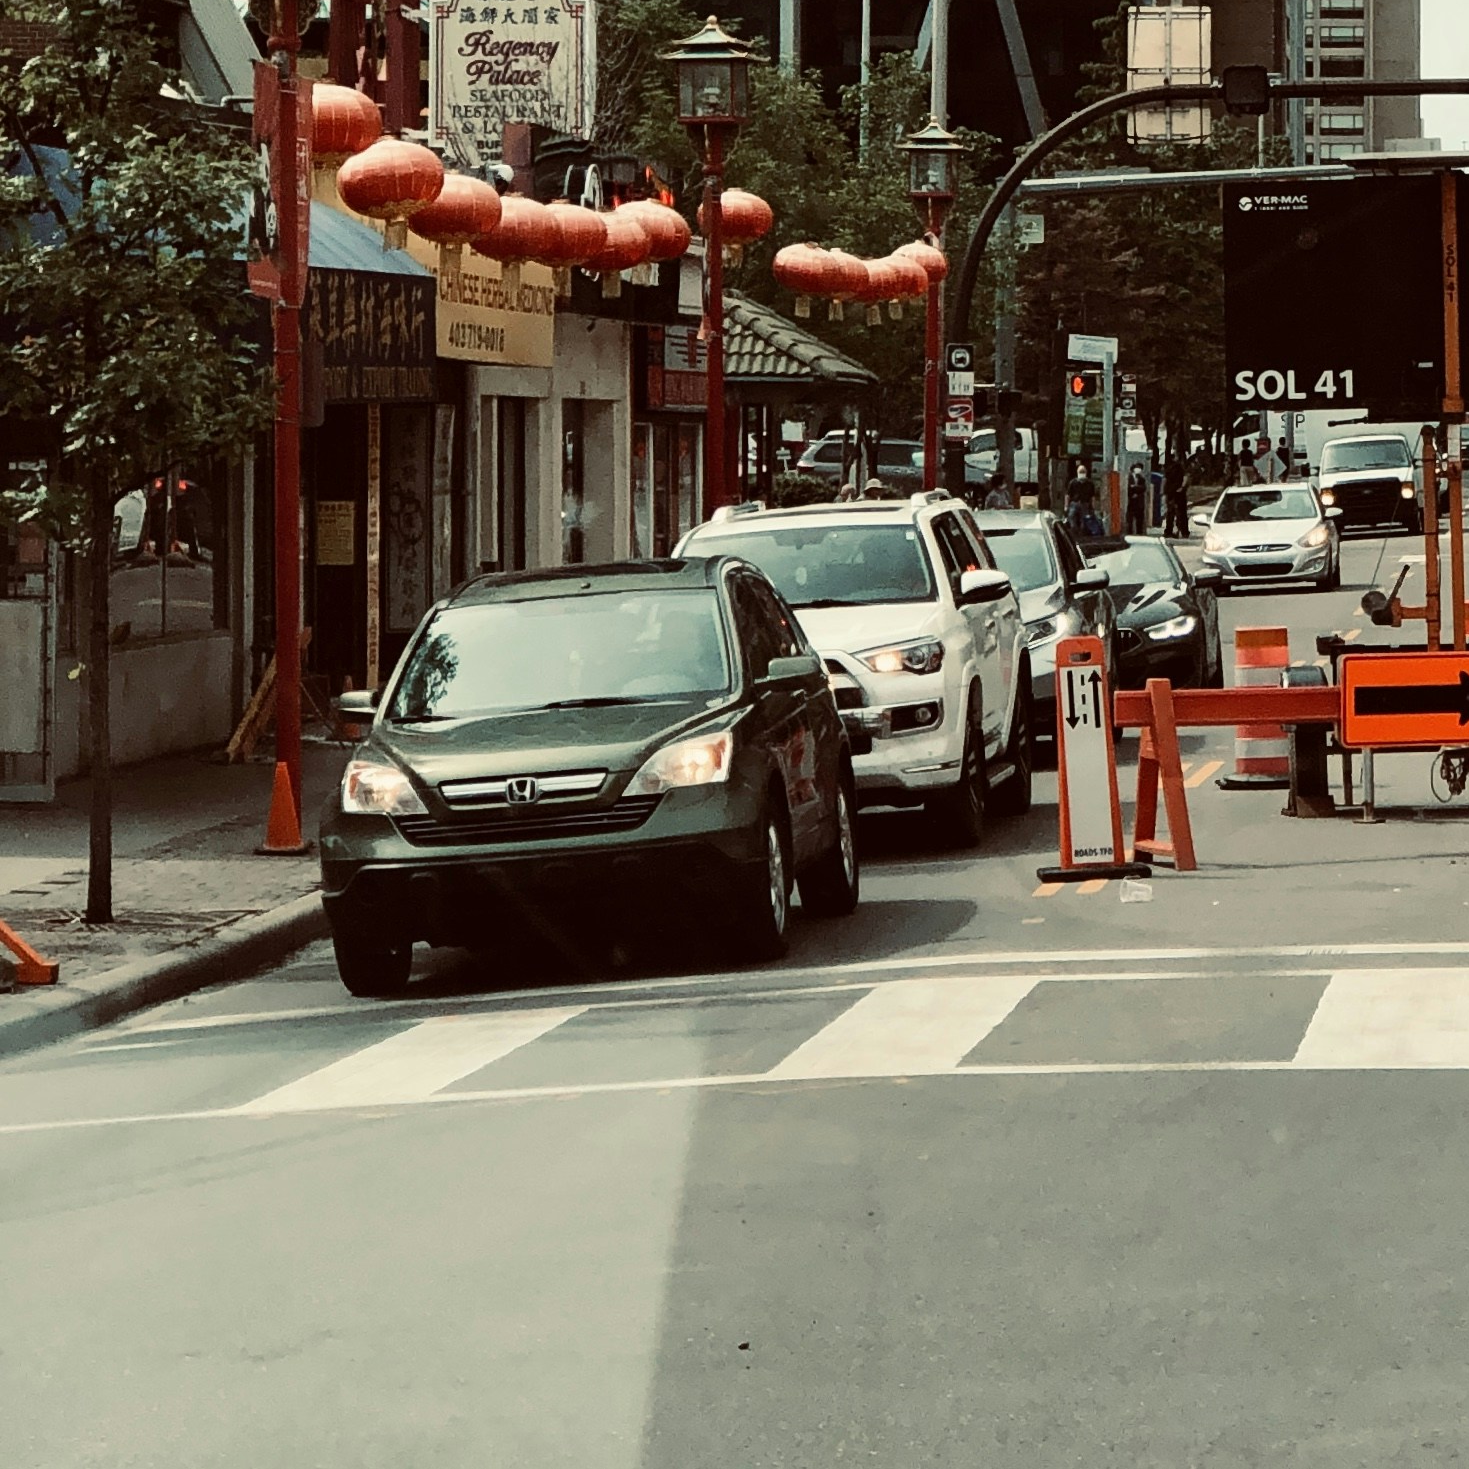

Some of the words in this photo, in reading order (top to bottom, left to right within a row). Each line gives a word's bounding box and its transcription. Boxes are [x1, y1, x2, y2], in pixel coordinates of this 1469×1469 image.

[457, 30, 560, 65] Regency
[465, 59, 543, 86] Palace
[469, 88, 549, 102] SEAFOOD
[452, 103, 565, 119] RESTAURANT
[1254, 195, 1308, 205] VER-MAC
[1445, 243, 1456, 278] SOL
[1235, 369, 1307, 401] SOL
[1314, 369, 1353, 399] 41
[1074, 847, 1098, 858] ROADS
